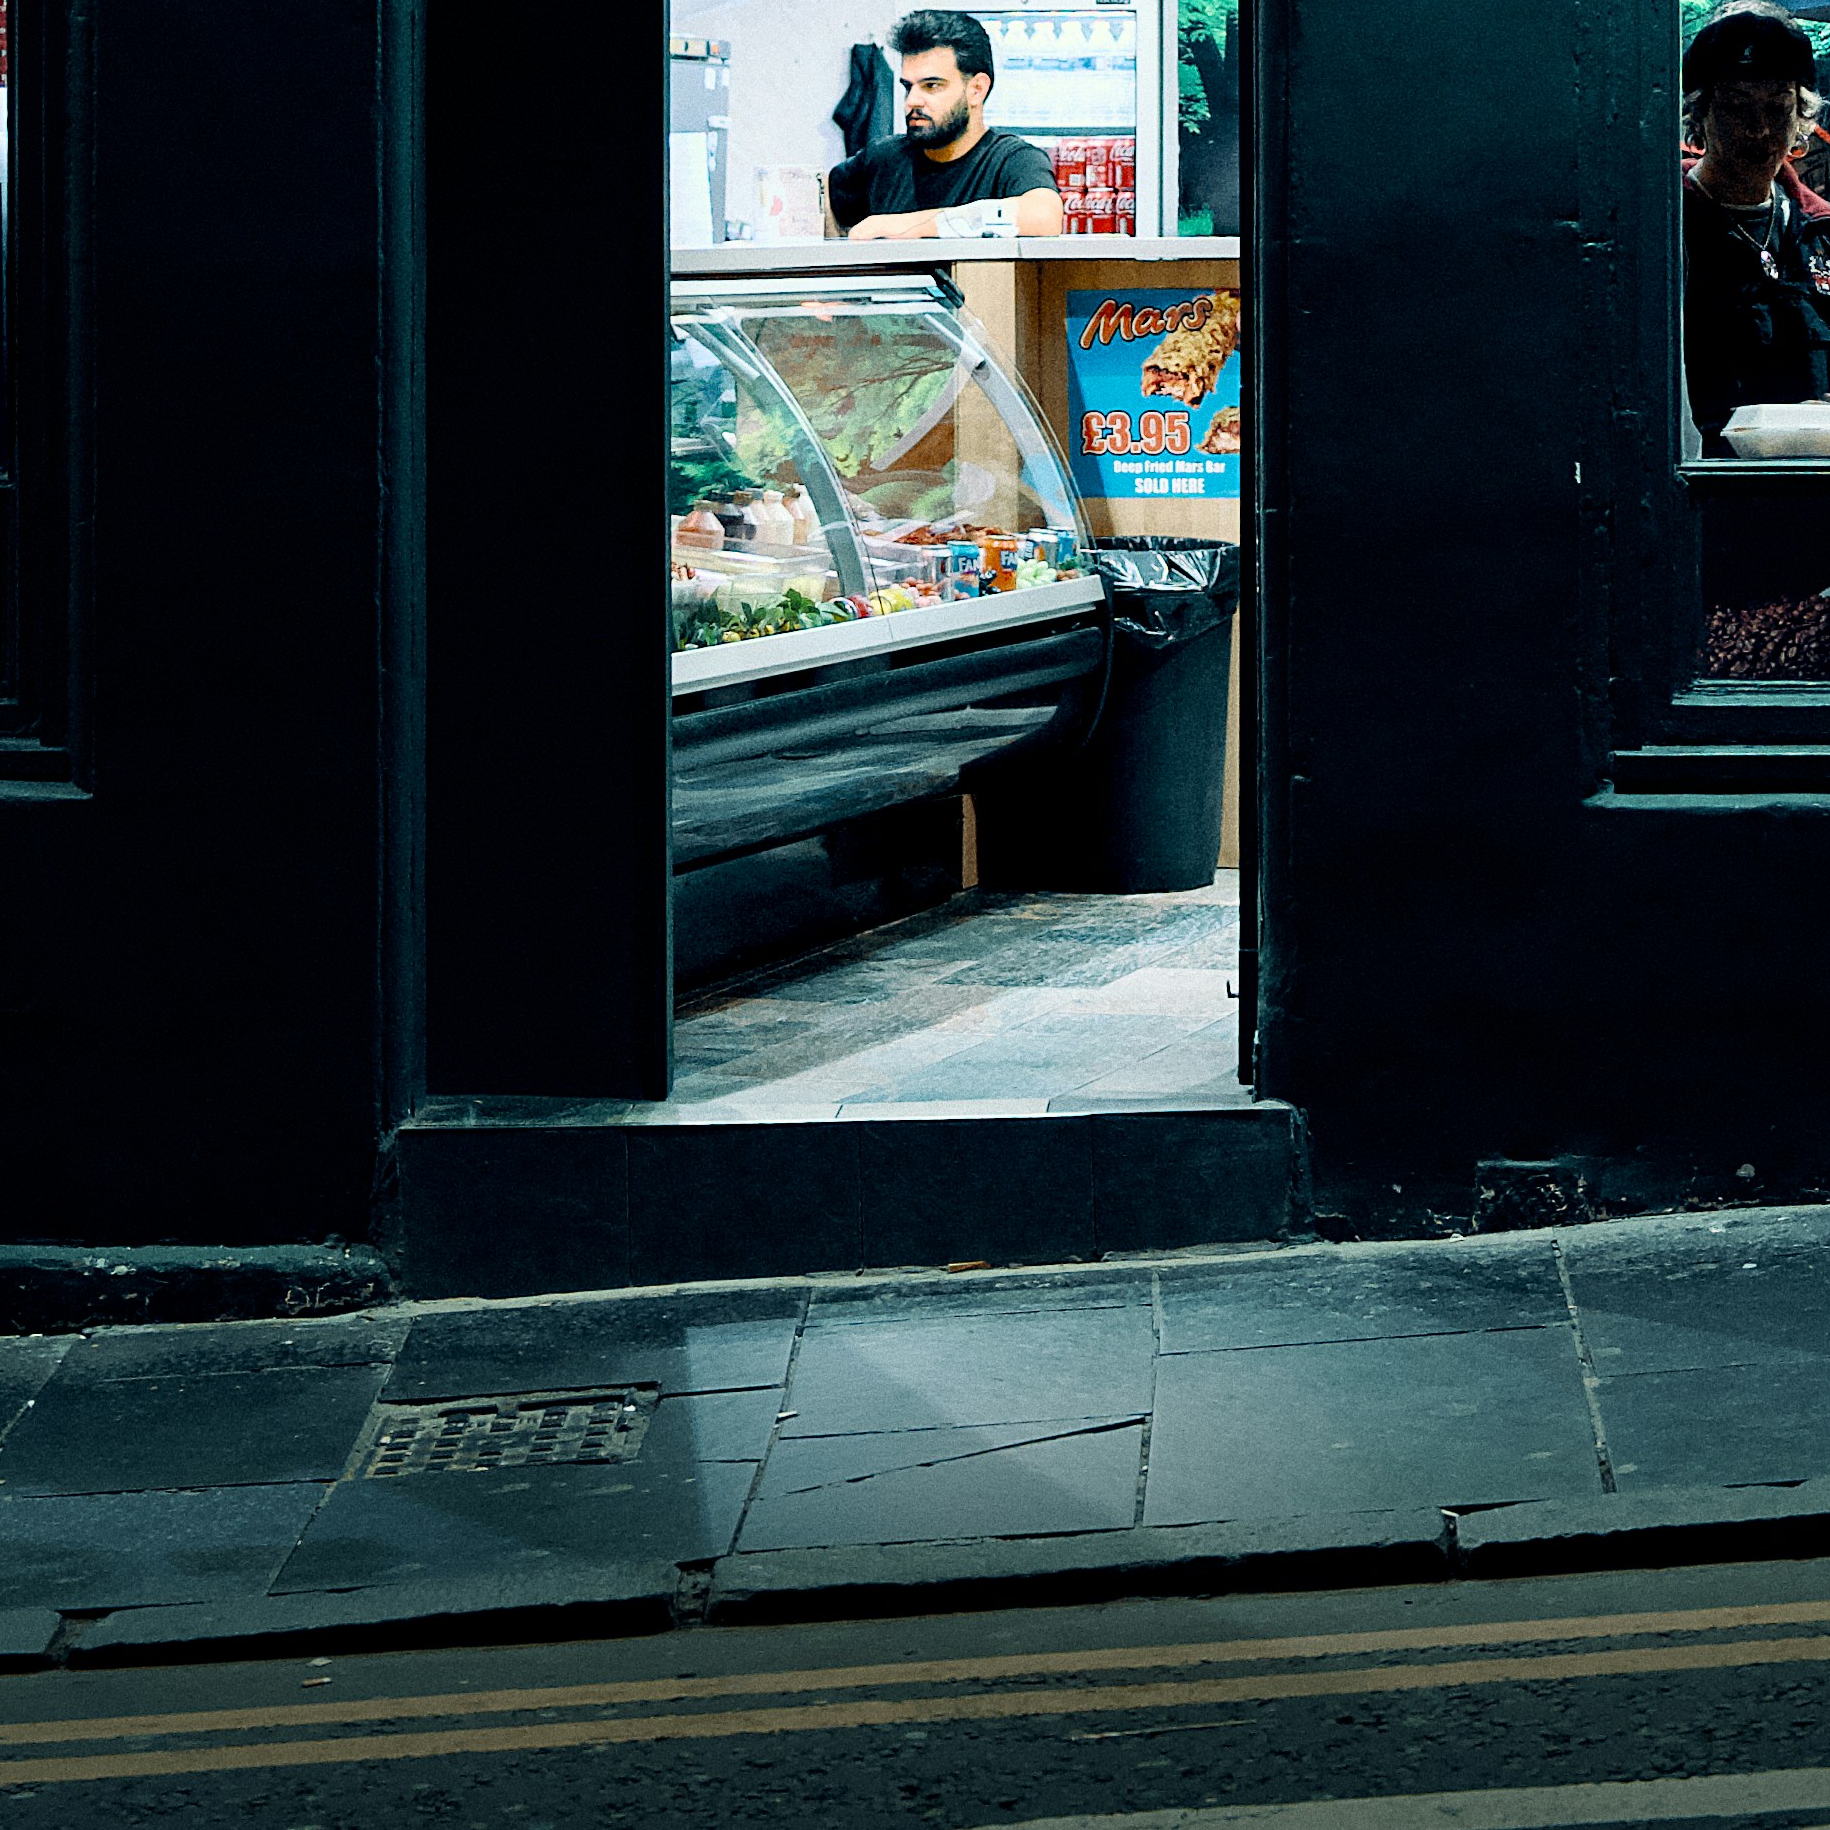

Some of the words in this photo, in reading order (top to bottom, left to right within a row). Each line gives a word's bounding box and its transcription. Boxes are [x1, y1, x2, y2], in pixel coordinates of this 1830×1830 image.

[1079, 294, 1214, 351] Mars
[1080, 410, 1191, 457] £3.95
[1113, 460, 1142, 475] Deep
[1144, 460, 1173, 474] Fried
[1175, 460, 1203, 474] Mars
[1205, 460, 1227, 474] Bar
[1134, 477, 1168, 496] SOLD
[1170, 477, 1206, 496] HERE
